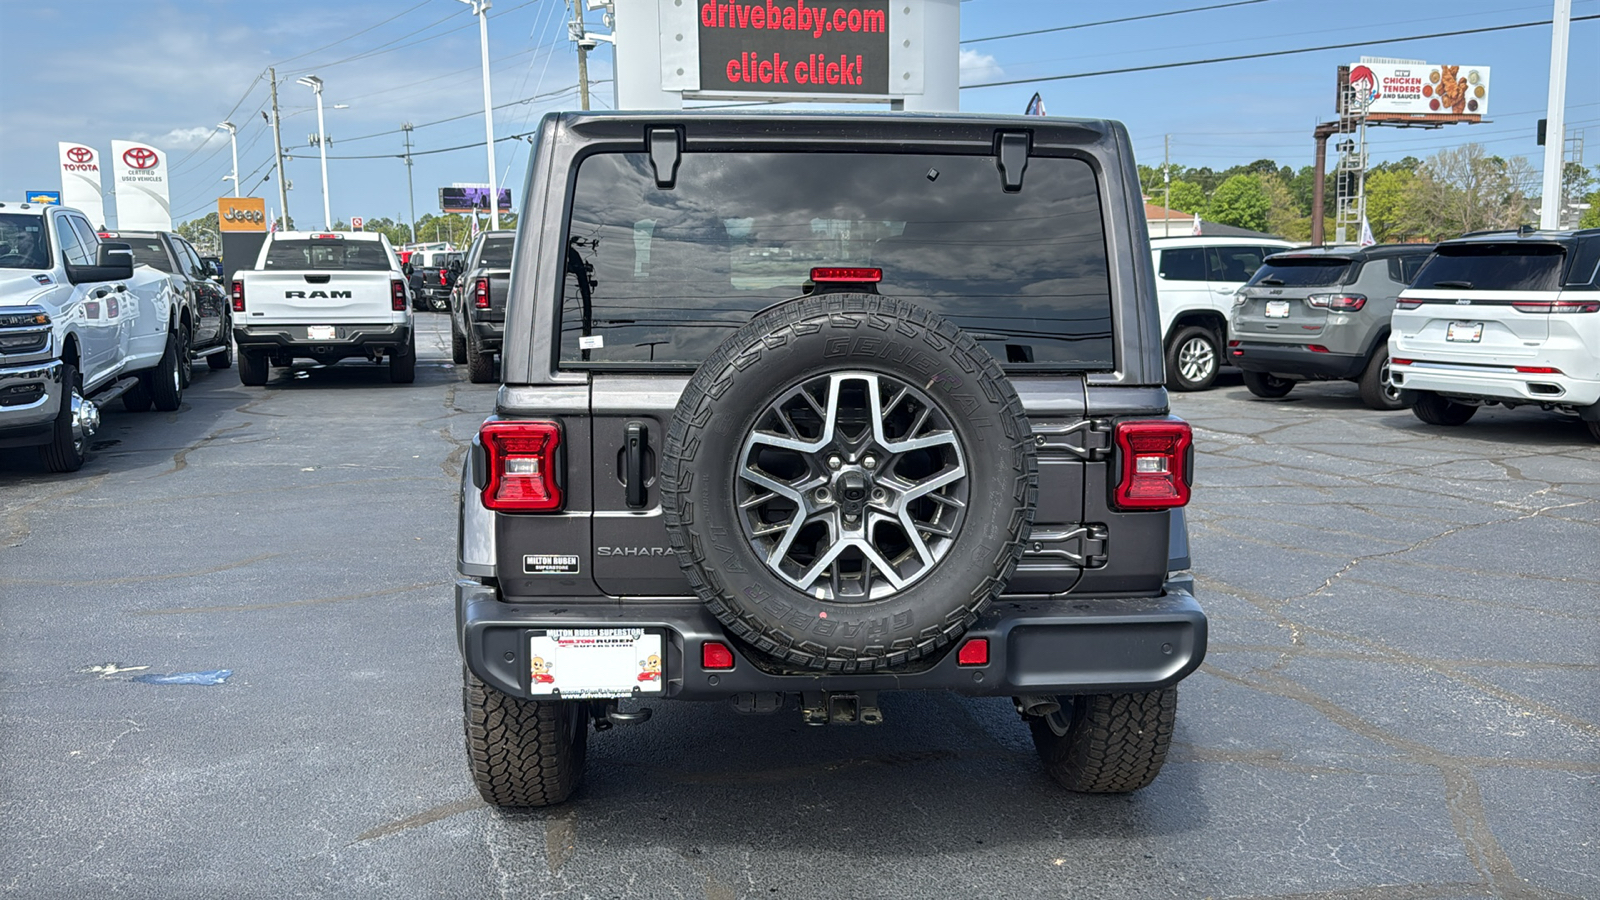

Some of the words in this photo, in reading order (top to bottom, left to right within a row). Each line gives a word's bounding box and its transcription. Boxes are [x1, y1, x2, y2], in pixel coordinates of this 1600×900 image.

[701, 0, 885, 39] drivebaby.com
[726, 52, 789, 83] click
[794, 53, 863, 86] click!
[1383, 77, 1422, 85] CHICKEN
[1382, 85, 1421, 93] TENDERS
[63, 163, 99, 172] TOYOTA
[223, 207, 264, 223] Jeep
[285, 290, 352, 299] RAM
[822, 335, 993, 442] GENERAL
[597, 546, 676, 557] SAHARA
[526, 556, 552, 565] MILTON
[553, 556, 577, 565] RUBEN
[546, 629, 574, 637] MILTON
[574, 629, 599, 637] RUBEN
[599, 628, 645, 637] SUPERSTORE
